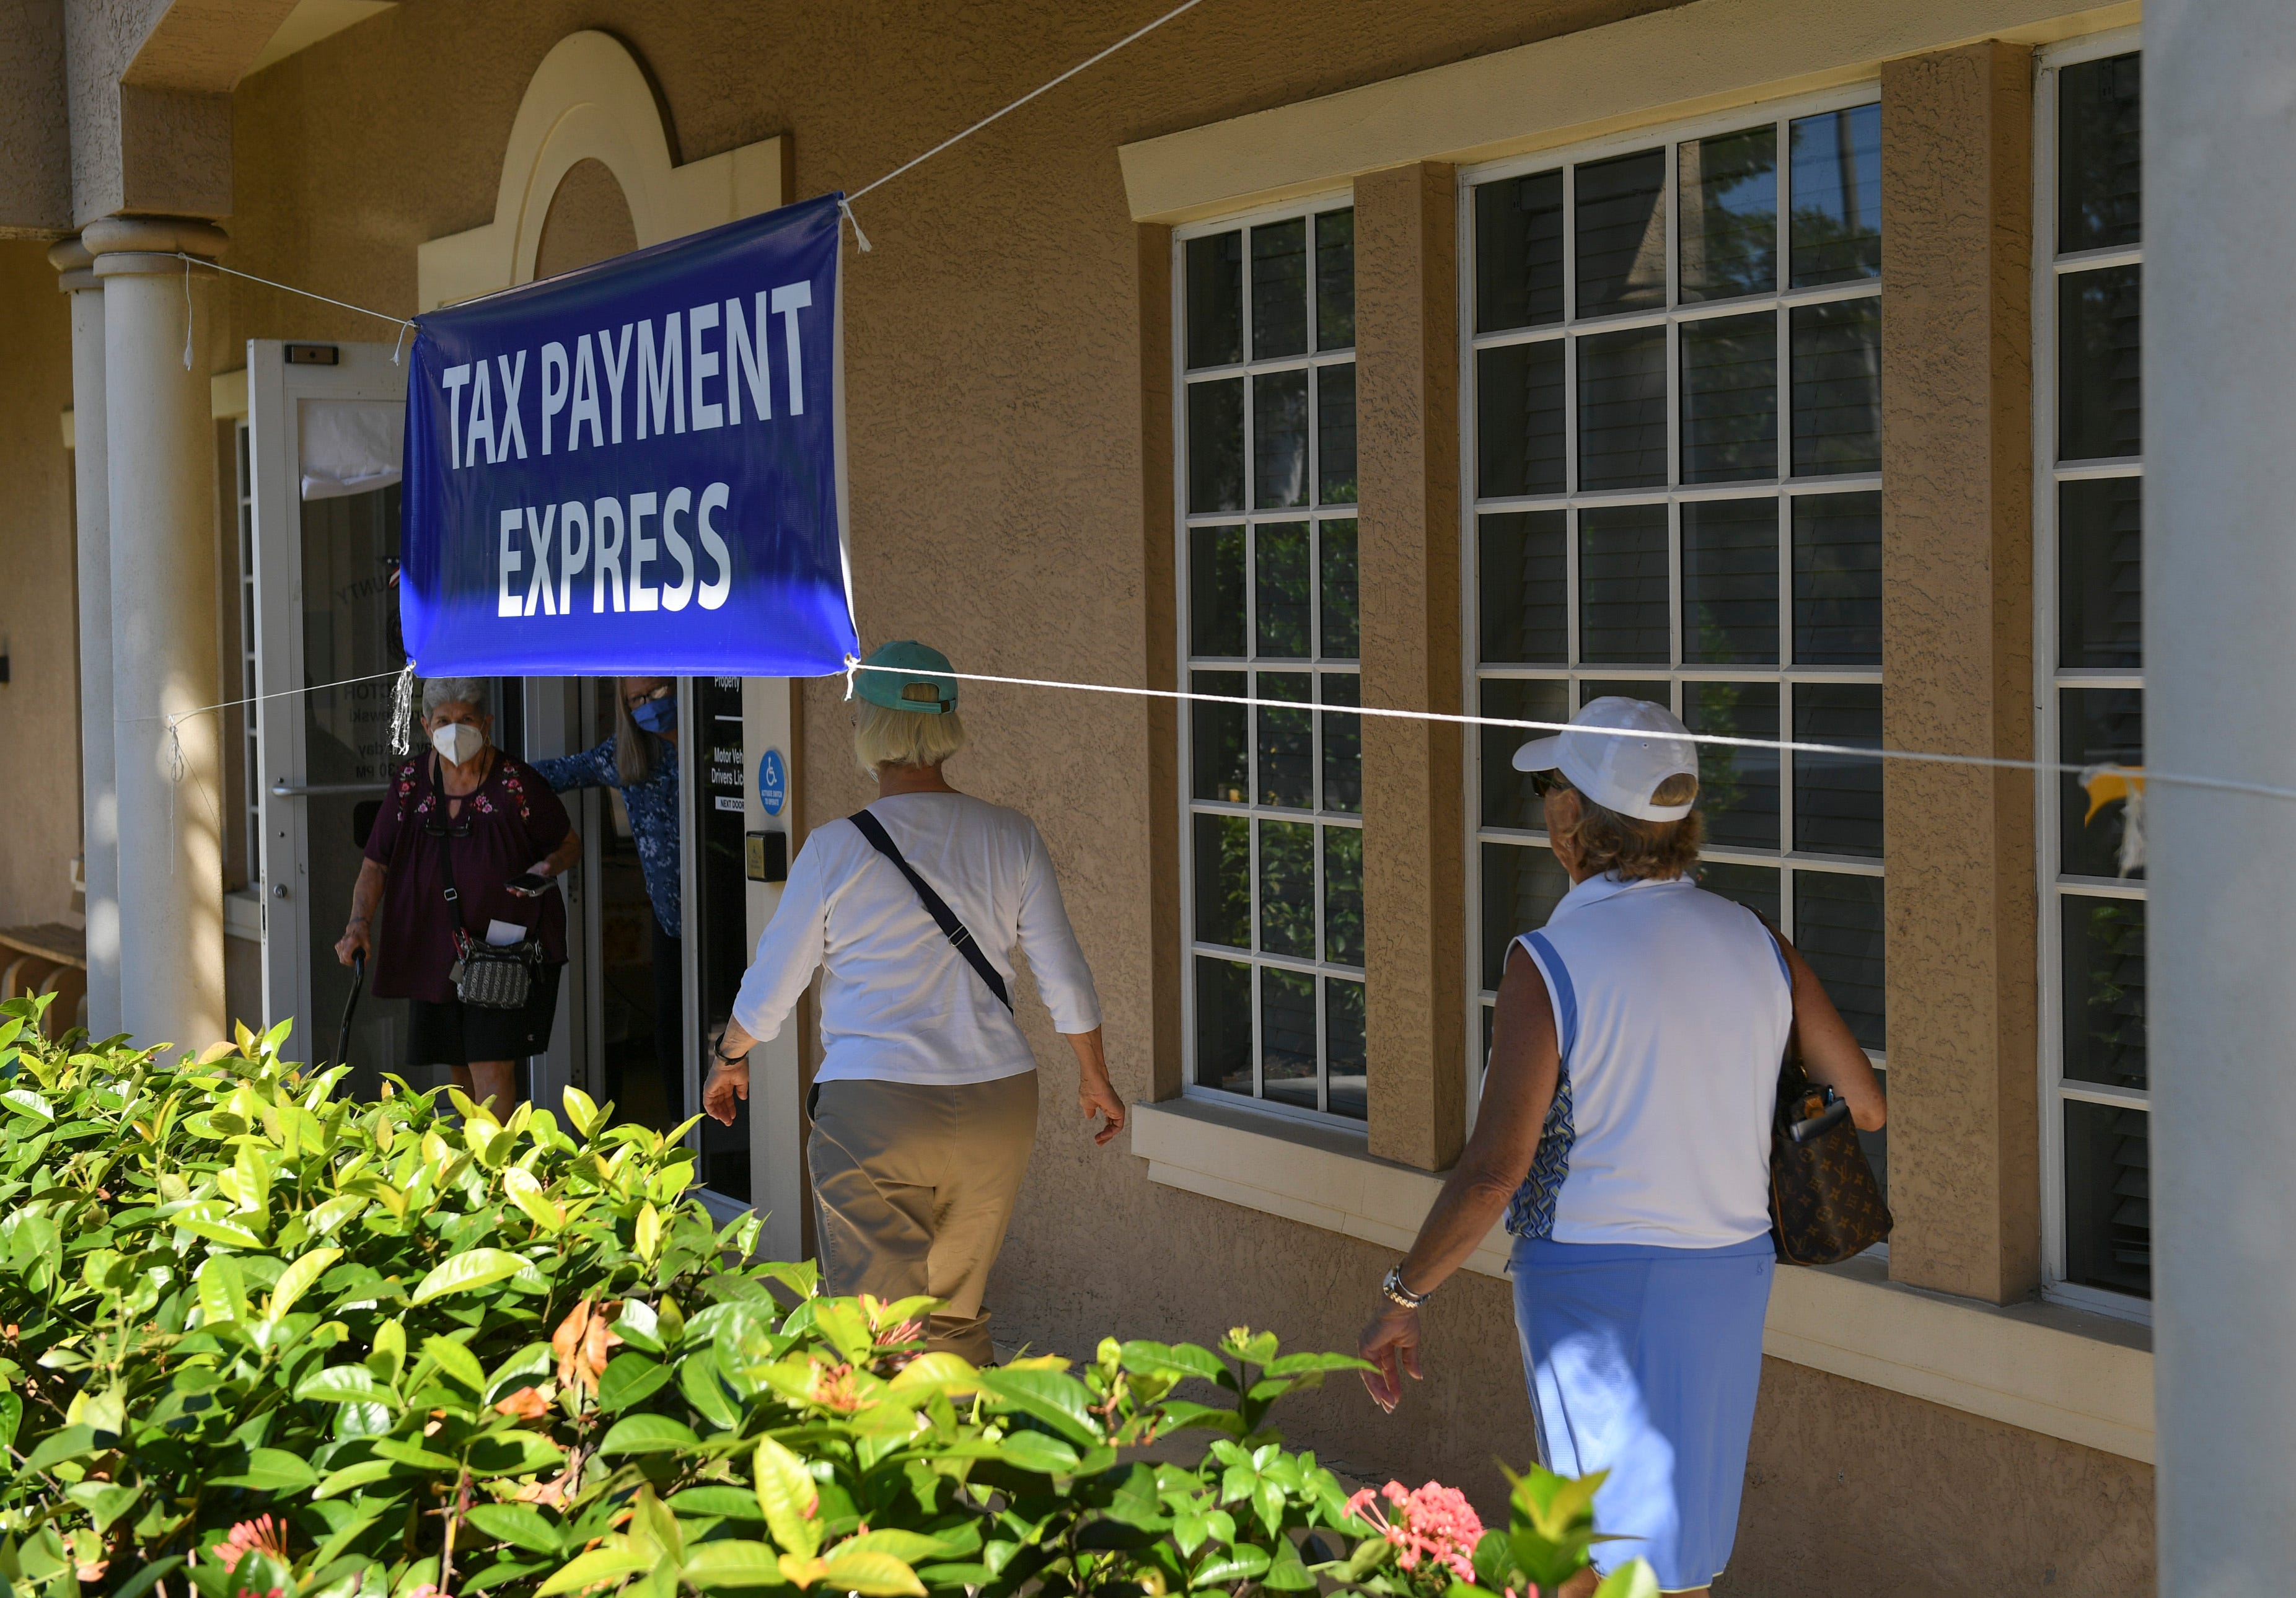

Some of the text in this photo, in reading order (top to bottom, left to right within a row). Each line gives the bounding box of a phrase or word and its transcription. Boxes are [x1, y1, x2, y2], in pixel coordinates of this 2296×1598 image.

[442, 279, 812, 470] TAX PAYMENT
[498, 482, 732, 618] EXPRESS
[715, 675, 740, 693] Property
[714, 747, 731, 763] Motor
[711, 767, 744, 786] Drivers Lic
[720, 798, 731, 809] NEXT
